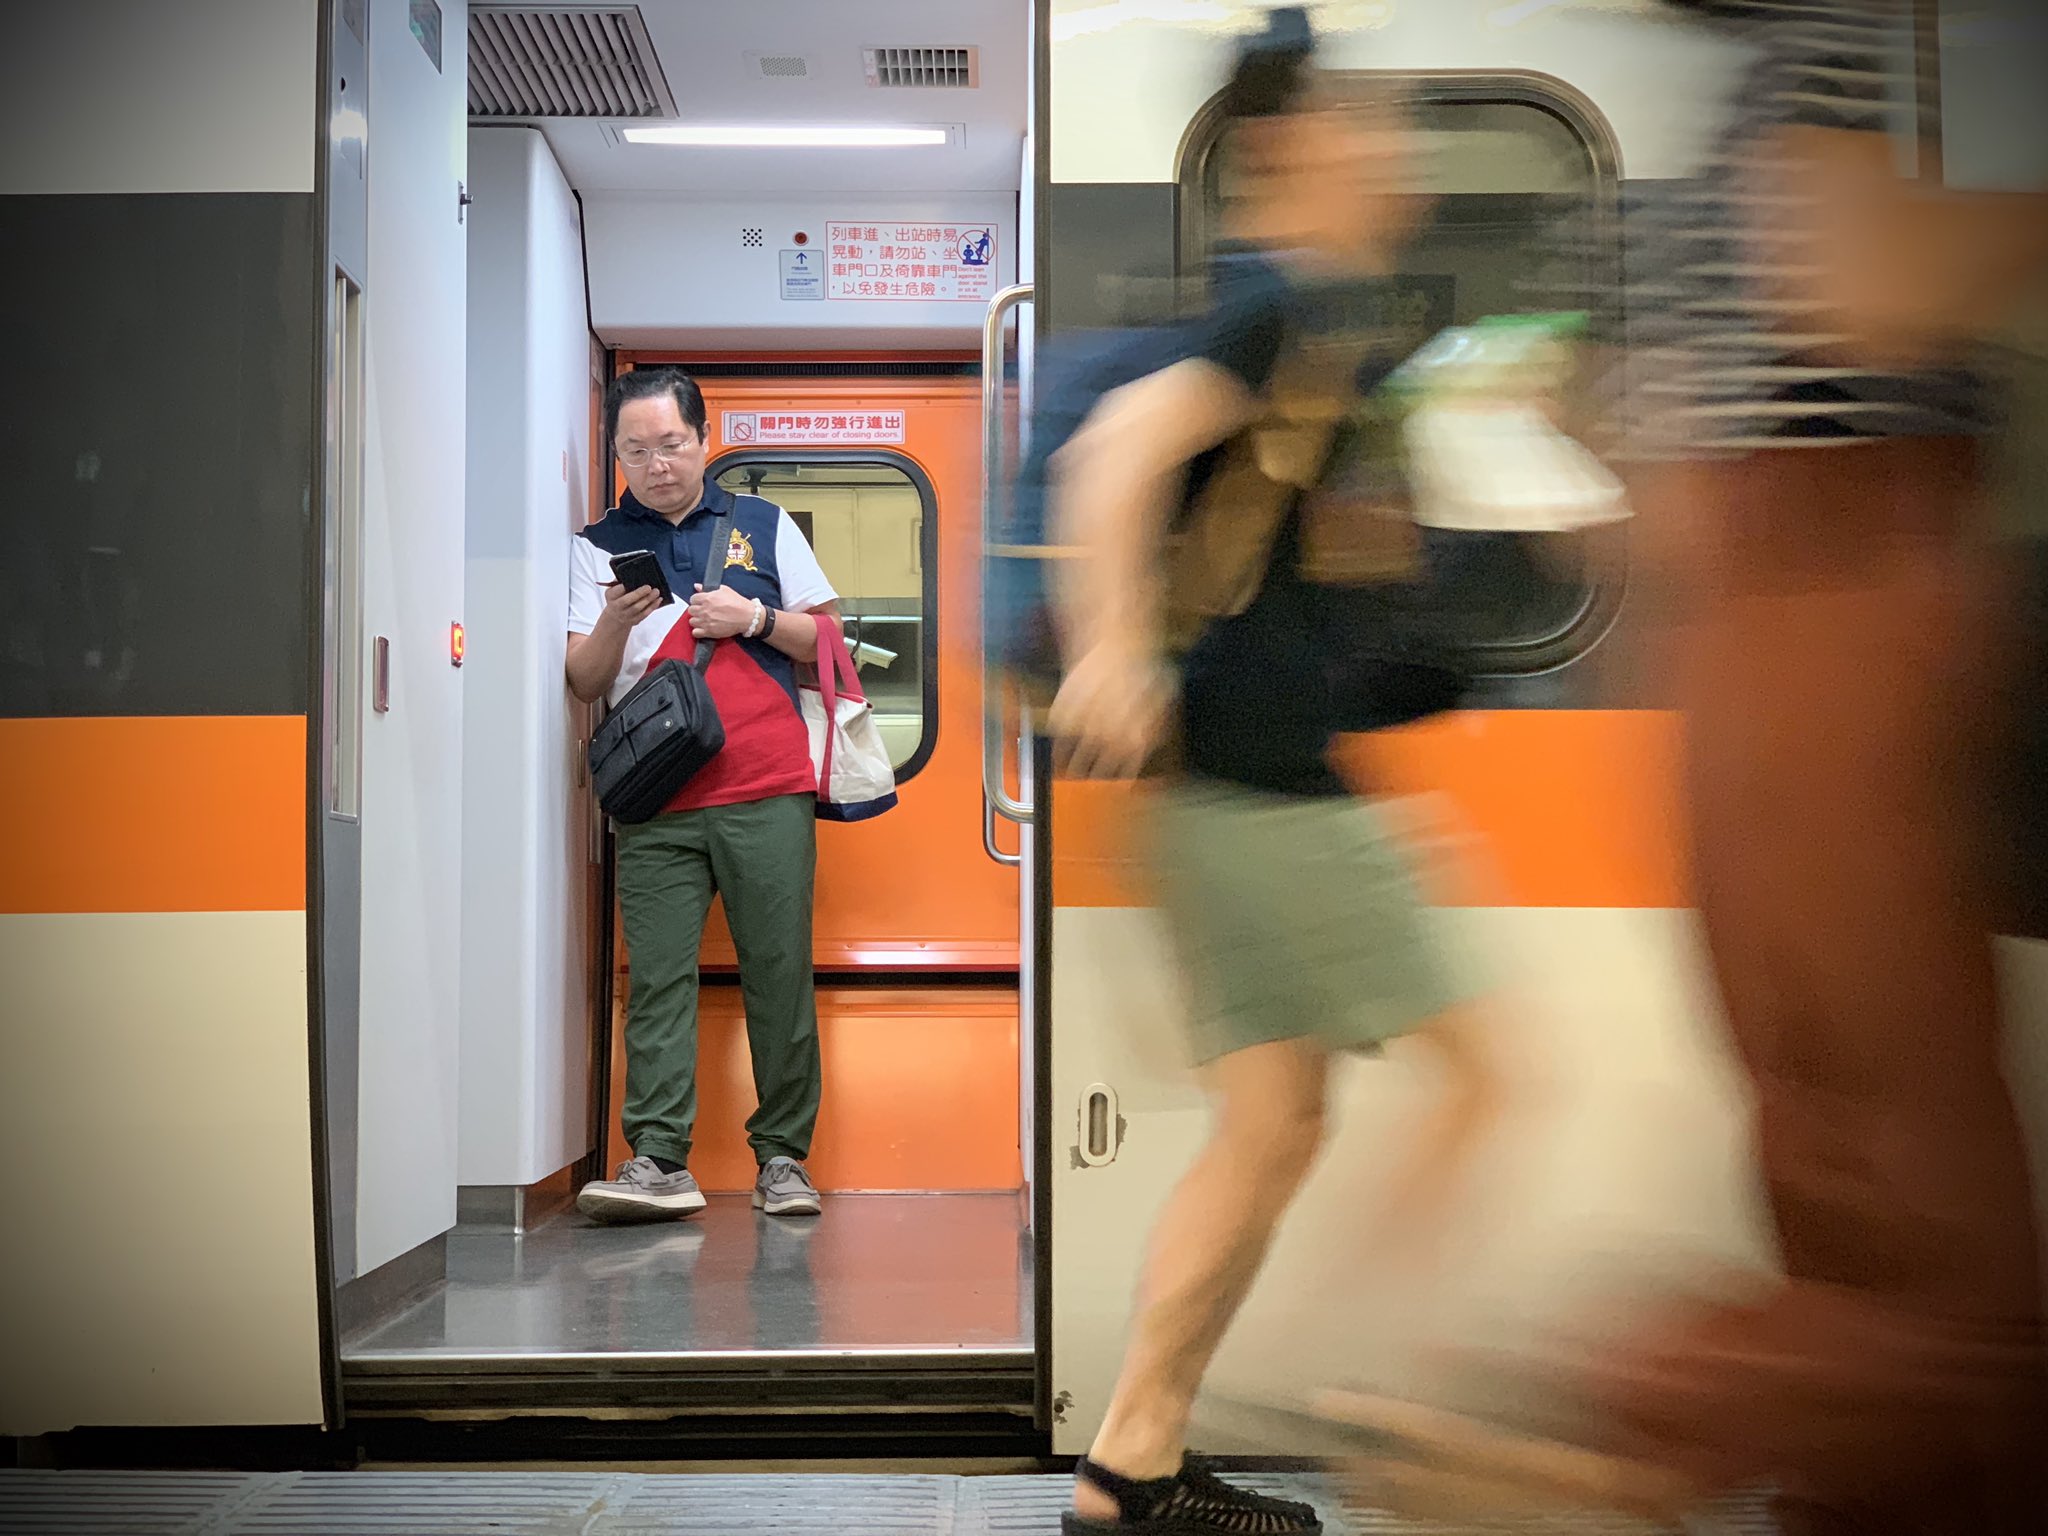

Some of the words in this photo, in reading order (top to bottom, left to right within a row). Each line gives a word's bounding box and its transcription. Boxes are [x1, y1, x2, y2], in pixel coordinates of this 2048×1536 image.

[832, 226, 957, 243] 列車進、出站時易
[832, 263, 957, 279] 車門口及倚靠車門
[760, 416, 900, 430] 關門時勿強行進出
[760, 431, 786, 439] Please
[842, 431, 872, 439] closing
